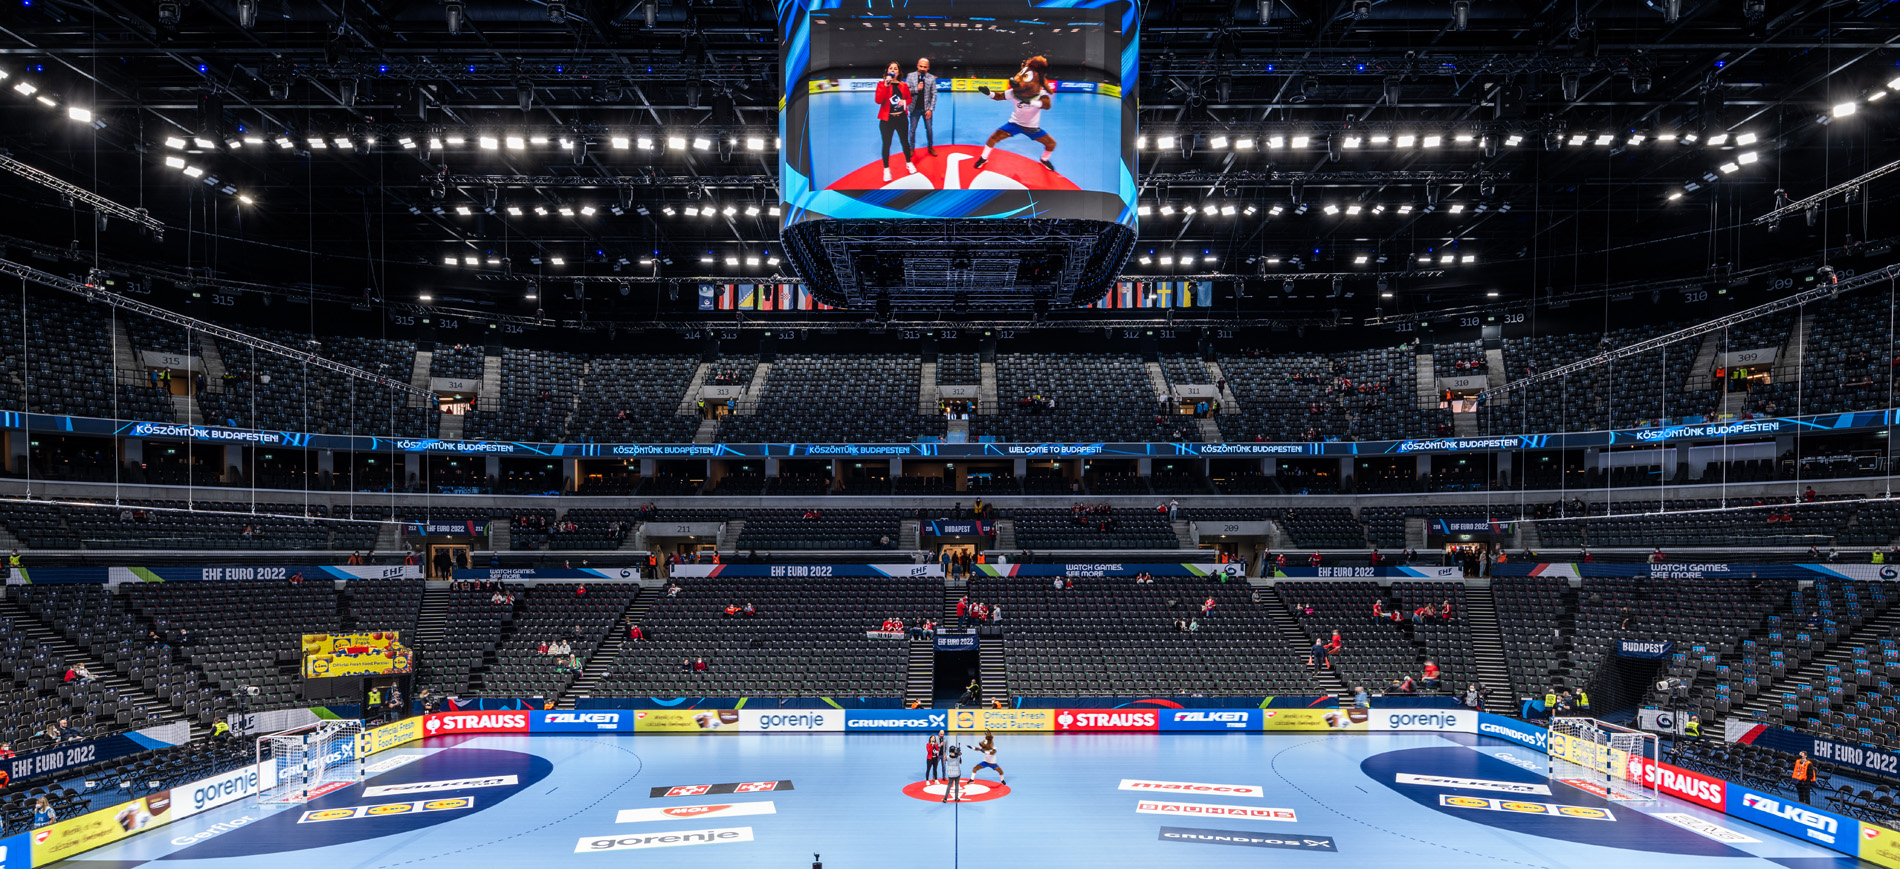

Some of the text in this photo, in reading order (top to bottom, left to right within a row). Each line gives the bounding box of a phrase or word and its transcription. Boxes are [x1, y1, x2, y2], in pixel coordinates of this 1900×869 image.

[211, 294, 235, 306] 315
[1684, 291, 1708, 303] 310
[395, 315, 414, 326] 315
[1460, 317, 1479, 327] 310
[1504, 313, 1524, 323] 310
[439, 319, 458, 329] 314
[504, 324, 523, 334] 314
[778, 331, 794, 340] 313
[903, 330, 920, 339] 313
[940, 330, 957, 339] 312
[1123, 330, 1139, 339] 312
[1160, 330, 1176, 339] 311
[1217, 330, 1233, 339] 311
[162, 357, 180, 366] 315
[1737, 352, 1758, 362] 309
[448, 381, 463, 389] 314
[1454, 379, 1469, 388] 310
[717, 388, 729, 396] 313
[1188, 387, 1200, 395] 311
[1706, 422, 1779, 435] BUDAPESTEN!
[211, 429, 279, 443] BUDAPESTEN!
[457, 443, 514, 453] BUDAPESTEN!
[1459, 438, 1518, 449] BUDAPESTEN!
[664, 446, 714, 454] BUDAPESTEN!
[860, 446, 910, 454] BUDAPESTEN!
[1009, 446, 1049, 454] WELCOME
[1252, 445, 1302, 453] BUDAPESTEN!
[677, 525, 691, 533] 211
[944, 525, 971, 533] BUDAPEST
[1474, 522, 1489, 530] 2022
[383, 567, 404, 577] EHF
[771, 566, 832, 576] EHF EURO 2022
[911, 566, 927, 575] EHF
[1318, 567, 1374, 577] EHF EURO 2022
[1438, 568, 1453, 576] EHF
[1688, 564, 1730, 572] GAMES.
[202, 567, 286, 581] EHF EURO 2022
[960, 637, 973, 645] 2022
[1622, 642, 1665, 654] BUDAPEST
[545, 713, 619, 722] FALKEN
[983, 711, 1045, 719] Official Fresh
[1076, 713, 1155, 727] STRAUSS
[1174, 712, 1249, 722] FALKEN
[1389, 711, 1457, 728] gorenje
[443, 714, 525, 729] STRAUSS
[760, 712, 824, 729] gorenje
[848, 719, 929, 728] GRUNDFOS
[984, 720, 1045, 729] Food Partner
[378, 721, 415, 738] Official Fresh
[1480, 723, 1536, 745] GRUNDFOS
[378, 736, 392, 748] Food
[393, 731, 414, 744] Partner
[12, 744, 96, 779] EHF EURO 2022
[1814, 739, 1898, 774] EHF EURO 2022
[194, 769, 257, 809] gorenje
[1131, 782, 1254, 794] mateco
[1645, 764, 1722, 804] STRAUSS
[670, 806, 709, 814] MOL
[1139, 803, 1295, 819] BAUHAUS
[1743, 792, 1839, 834] FALKEN
[590, 831, 740, 850] gorenje
[1163, 832, 1301, 846] GRUNDFOS
